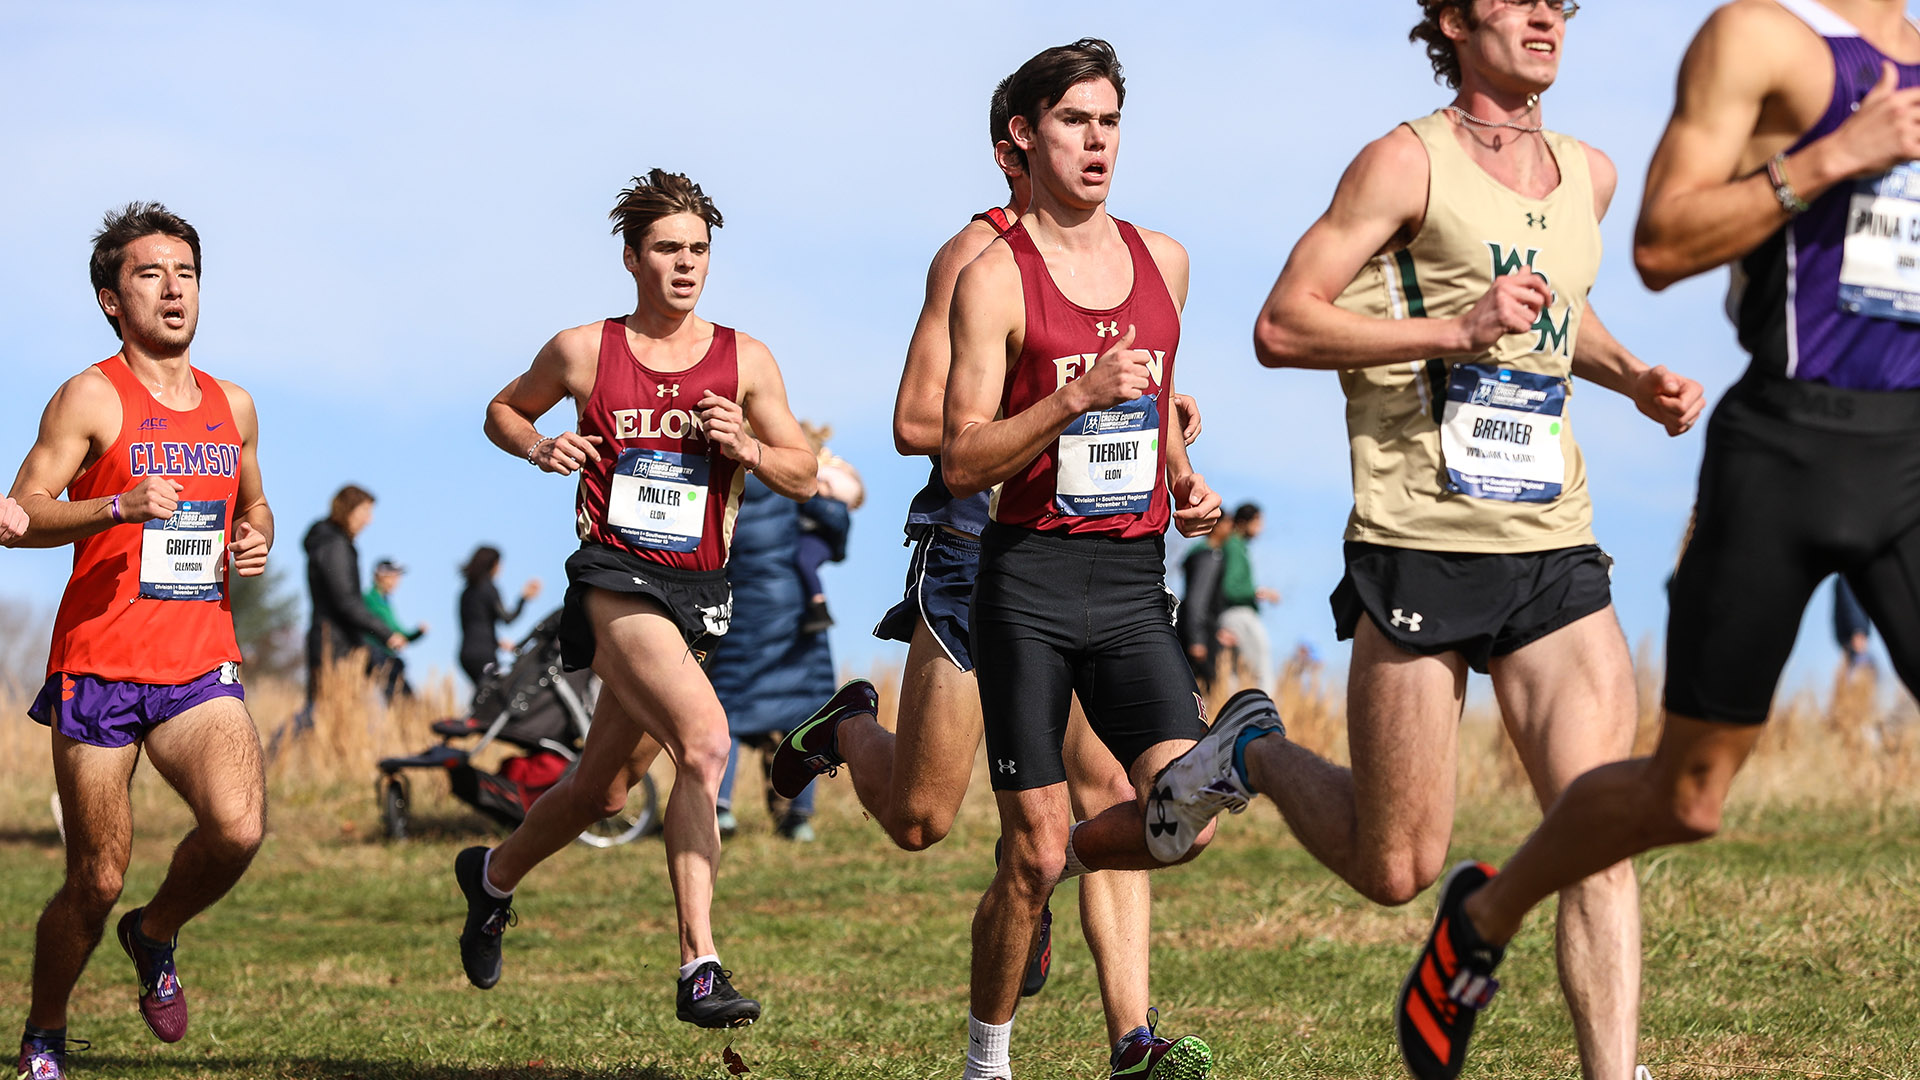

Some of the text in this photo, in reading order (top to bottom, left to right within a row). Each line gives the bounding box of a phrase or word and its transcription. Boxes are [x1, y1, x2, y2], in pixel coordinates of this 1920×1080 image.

[1052, 349, 1166, 392] EN
[140, 417, 168, 428] ACC
[612, 408, 710, 443] ELON
[1101, 413, 1119, 422] CROSS
[1120, 411, 1145, 421] COUNTRY
[1472, 417, 1533, 445] BREMER
[129, 441, 240, 479] CLEMSON
[1088, 441, 1139, 463] TIERNEY
[1105, 469, 1122, 480] ELON
[638, 485, 681, 506] MILLER
[1127, 493, 1148, 502] Regional
[650, 510, 667, 520] ELON
[166, 538, 212, 556] GRIFFITH
[174, 562, 203, 571] CLEMSON
